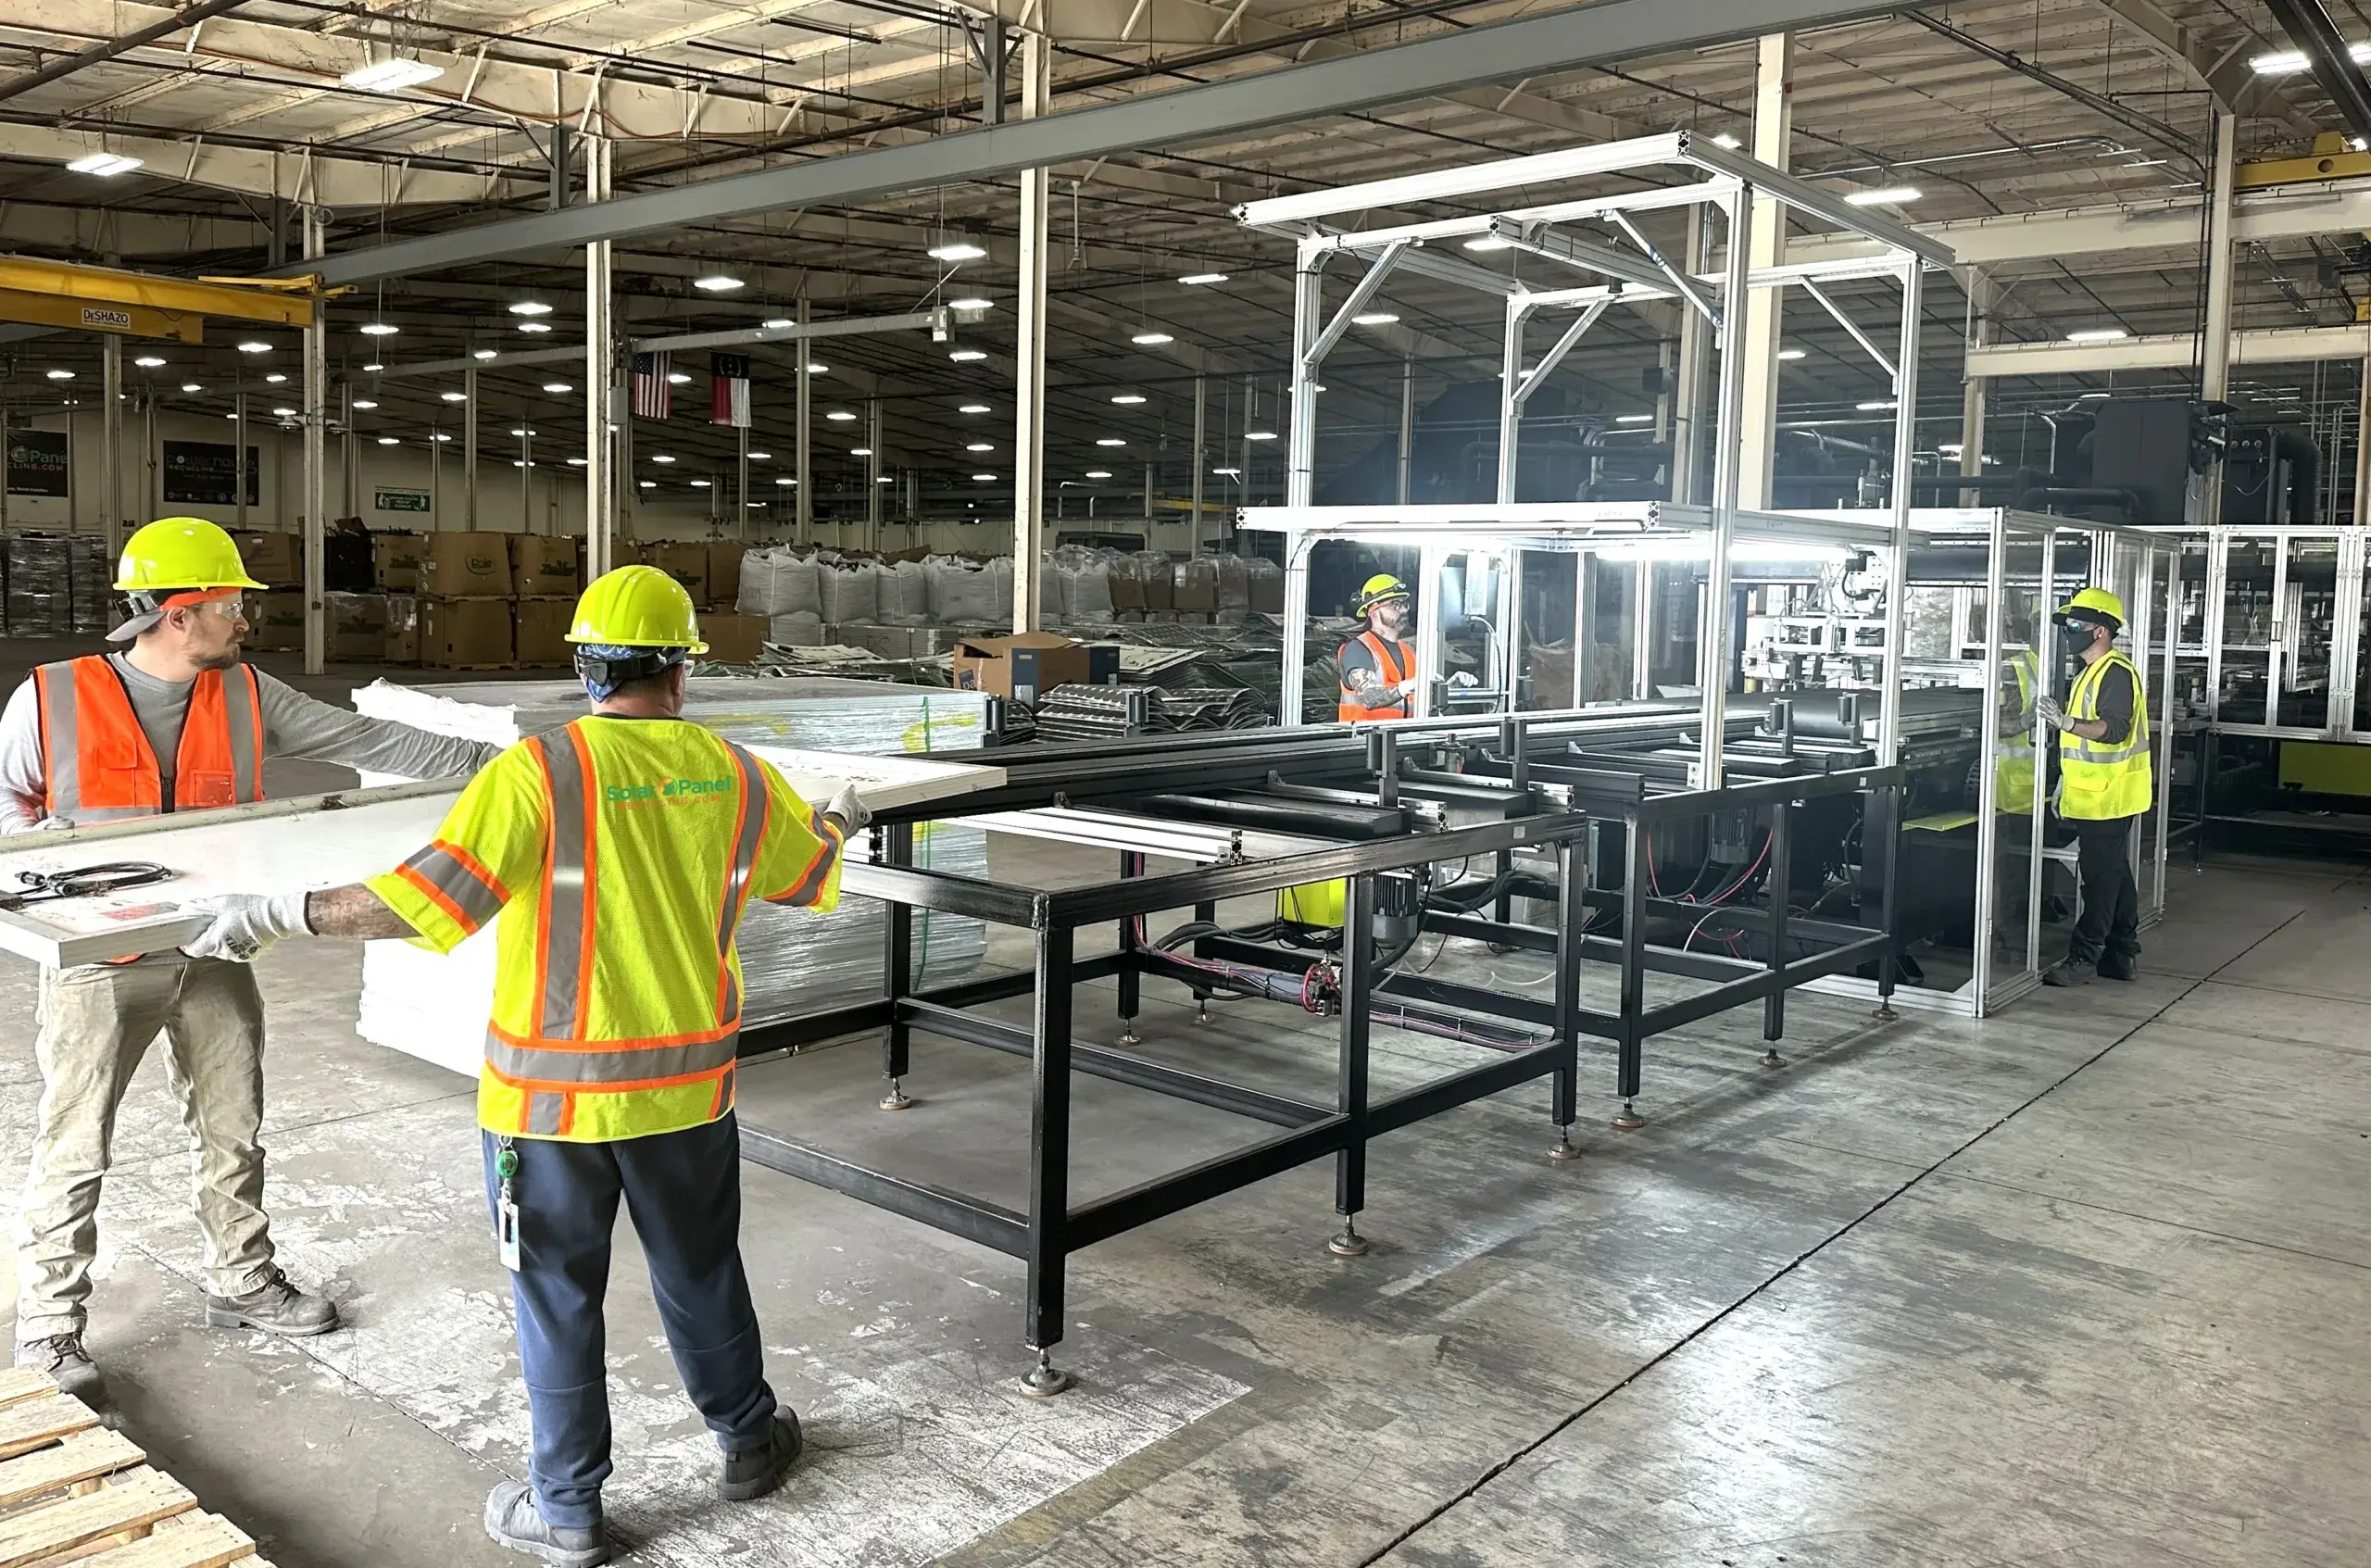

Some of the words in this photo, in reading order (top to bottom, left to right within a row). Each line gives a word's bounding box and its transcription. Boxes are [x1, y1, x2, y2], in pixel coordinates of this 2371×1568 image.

[30, 450, 68, 464] Pane
[6, 462, 64, 470] CLING.COM
[607, 784, 653, 801] Solar
[679, 775, 731, 795] Panel
